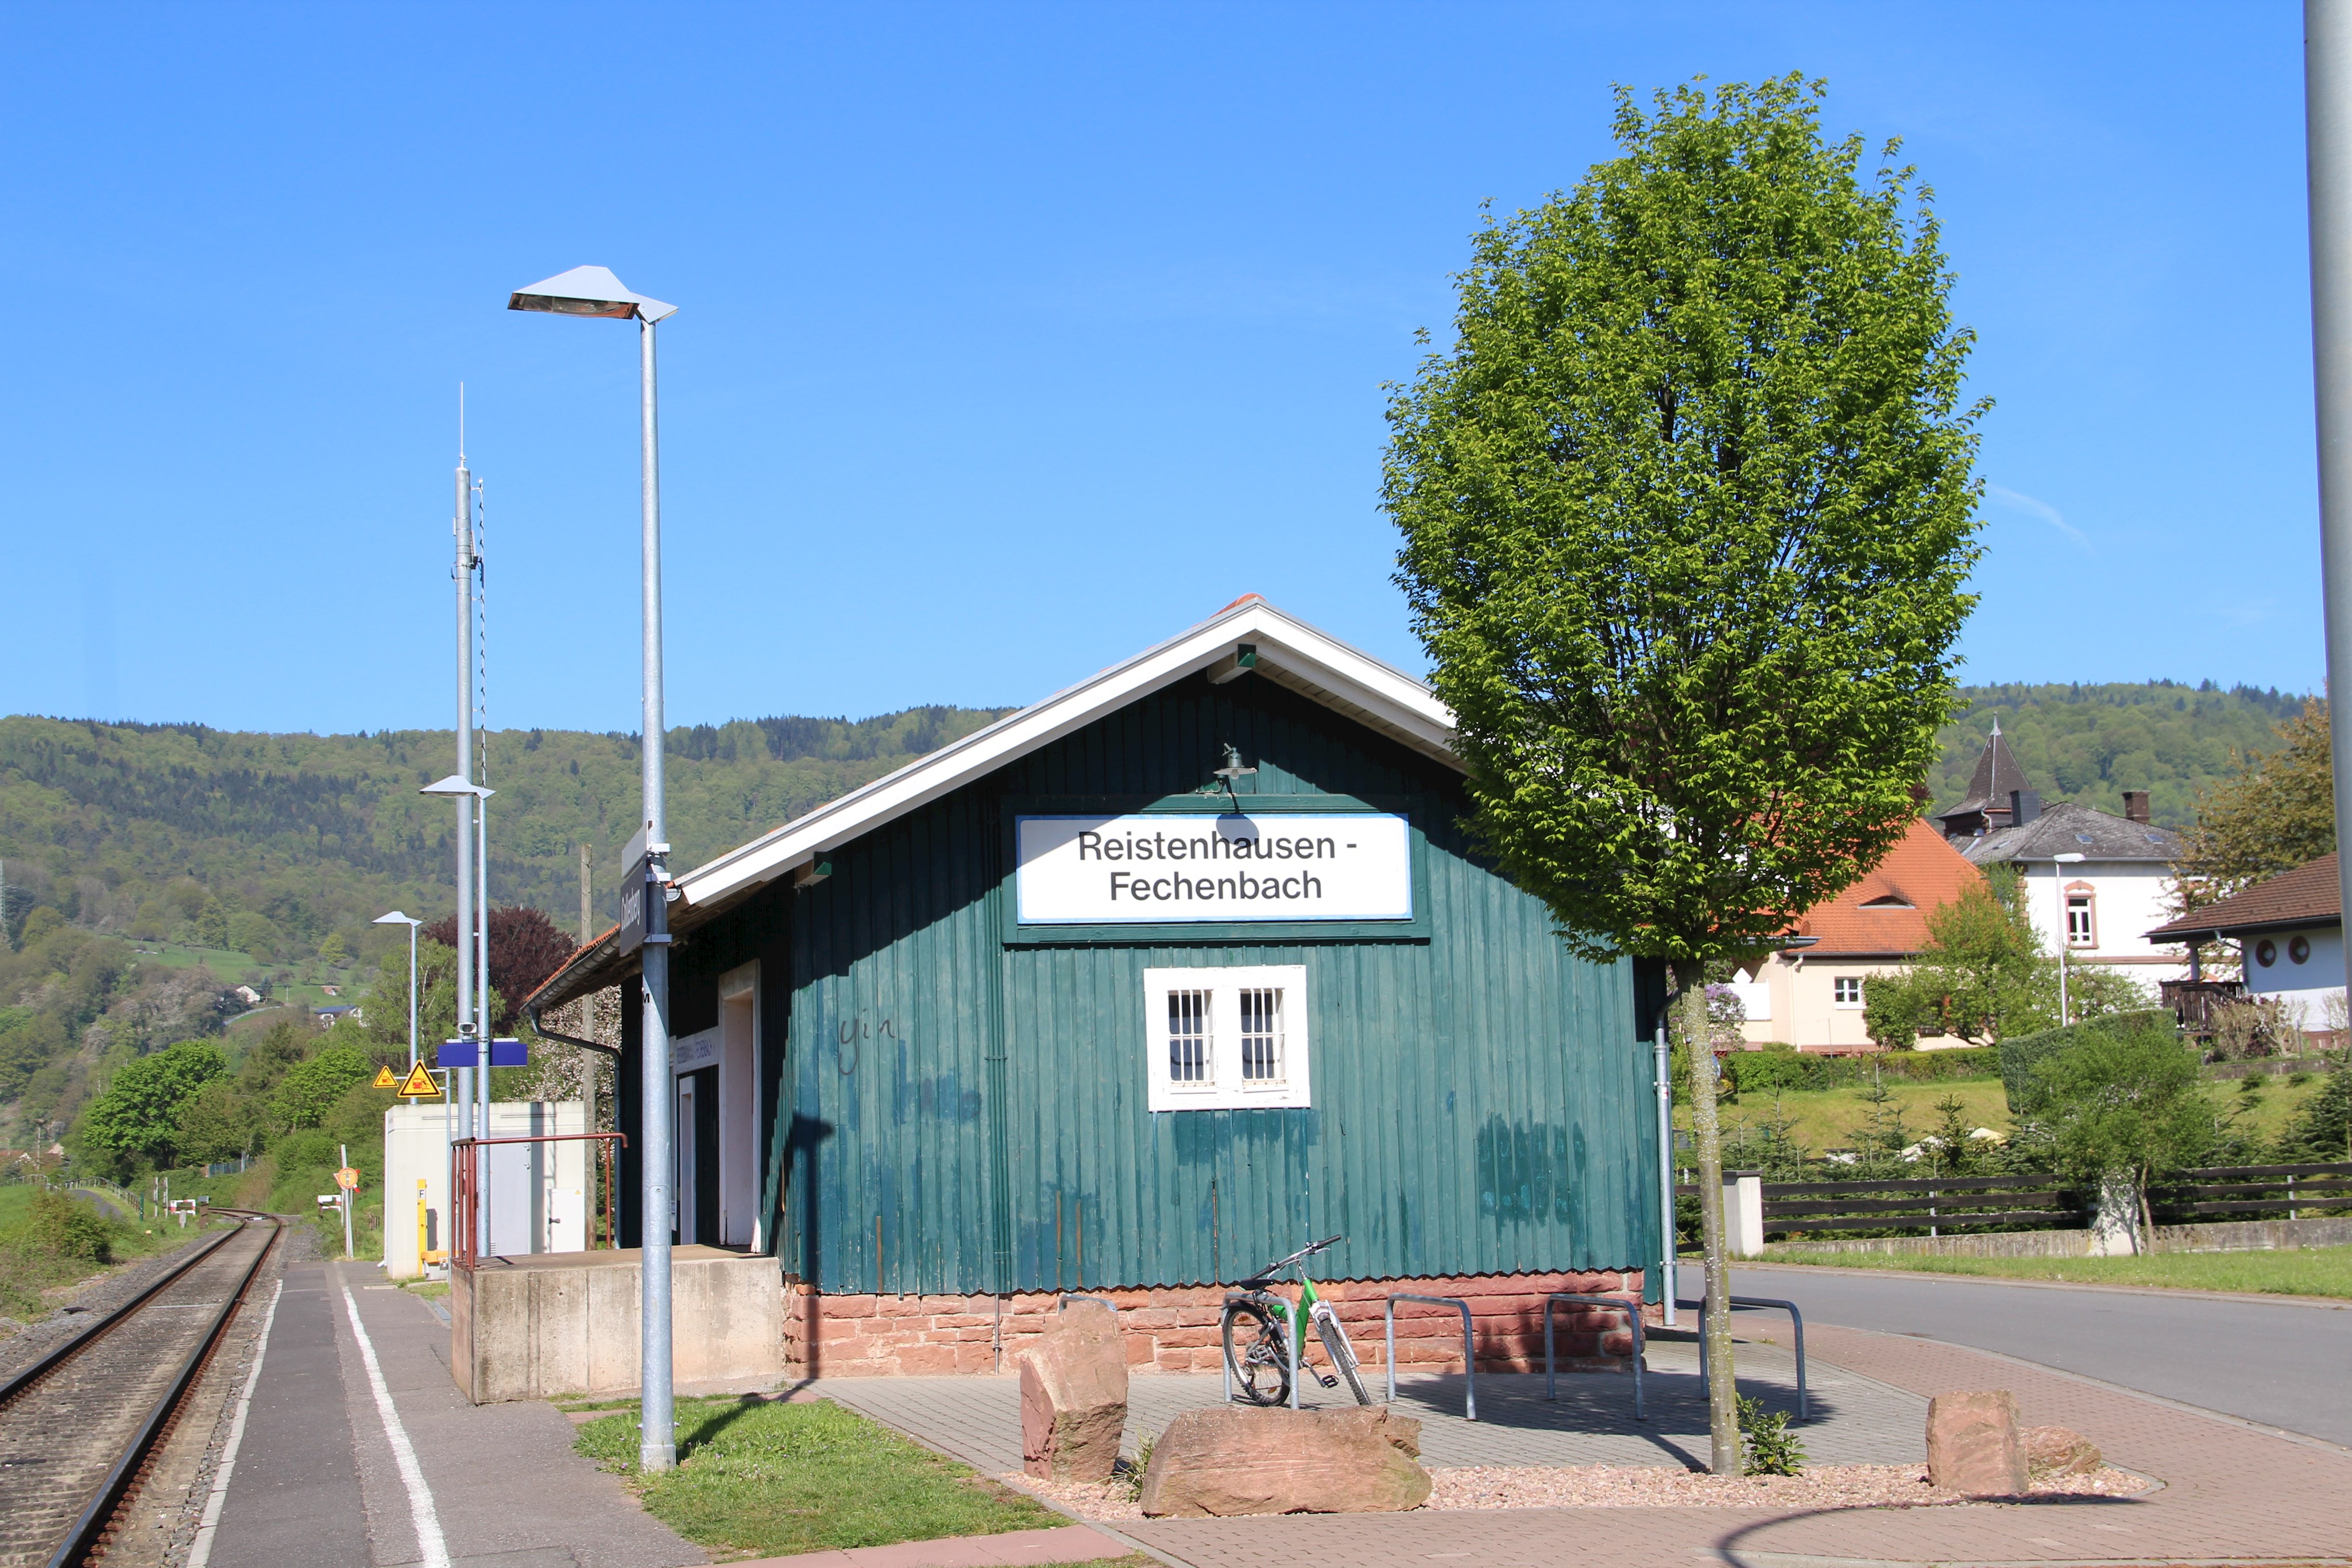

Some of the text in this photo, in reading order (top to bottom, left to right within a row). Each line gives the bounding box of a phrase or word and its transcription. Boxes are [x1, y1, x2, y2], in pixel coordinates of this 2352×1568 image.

[1078, 831, 1336, 861] Reistenhausen
[1110, 871, 1322, 901] Fechenbach
[621, 887, 640, 932] Collenberg
[419, 1190, 424, 1198] F
